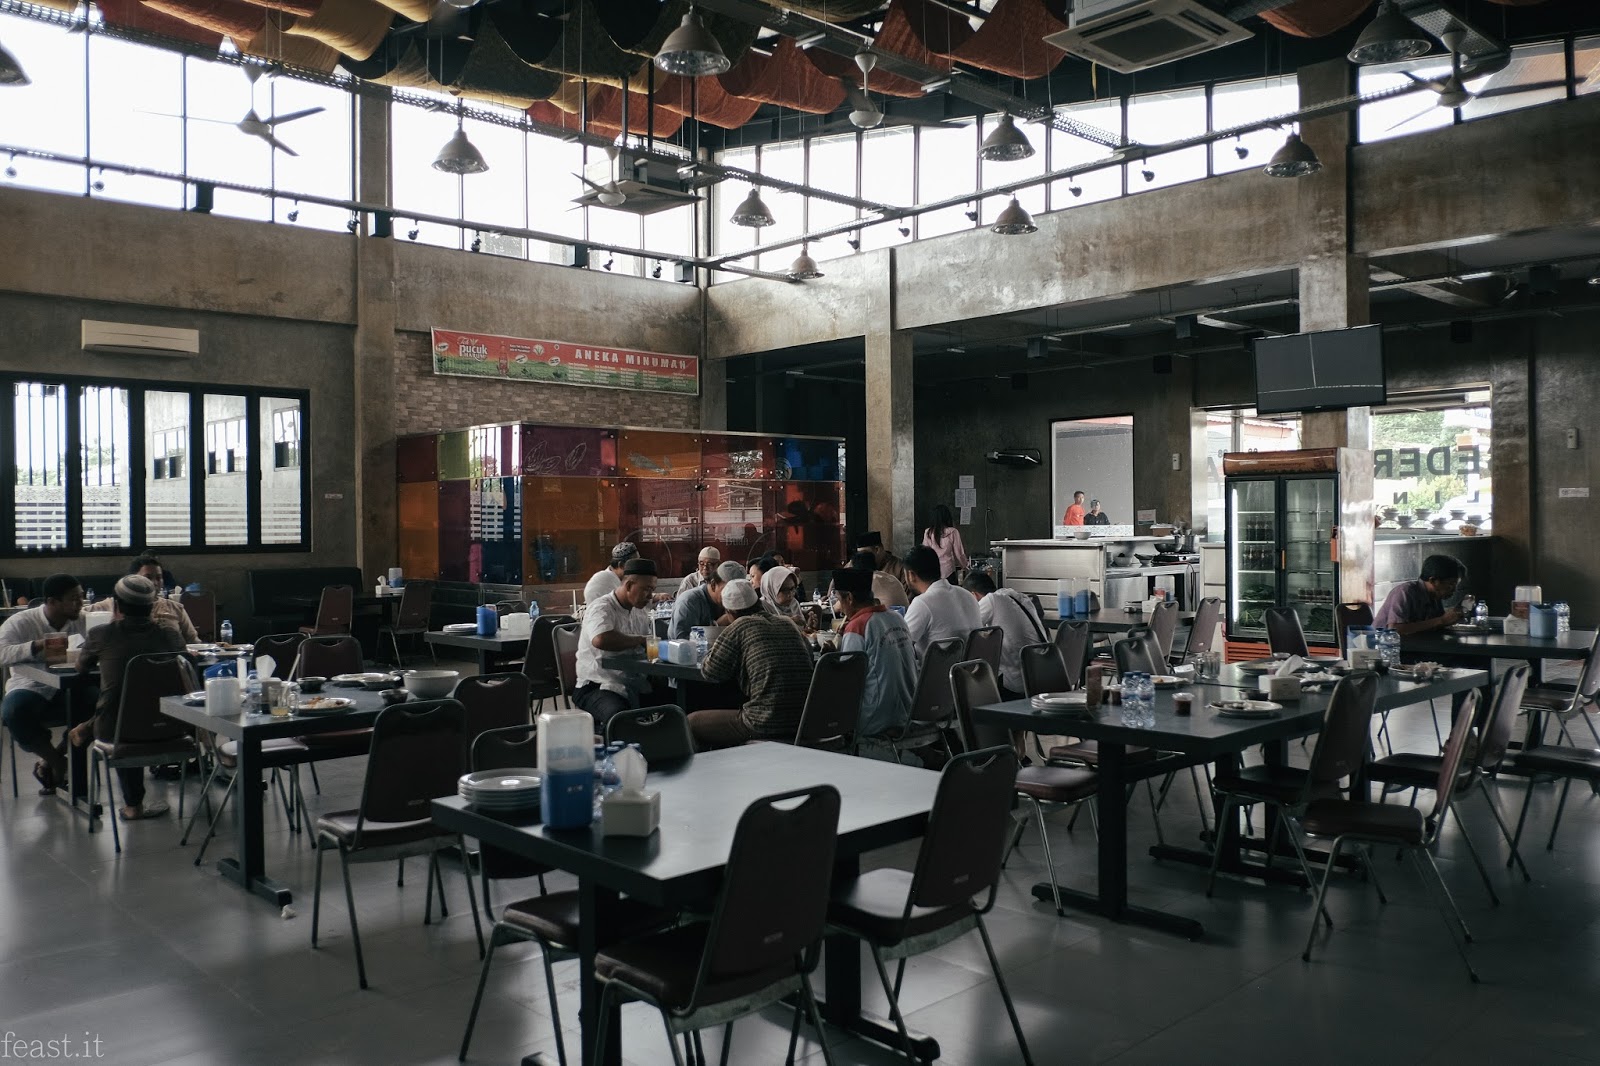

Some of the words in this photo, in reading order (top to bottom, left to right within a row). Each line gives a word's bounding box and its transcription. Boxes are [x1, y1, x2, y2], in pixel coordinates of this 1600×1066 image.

[459, 344, 488, 357] pucuk
[575, 349, 619, 363] ANEKA
[625, 354, 686, 369] MINUMAN
